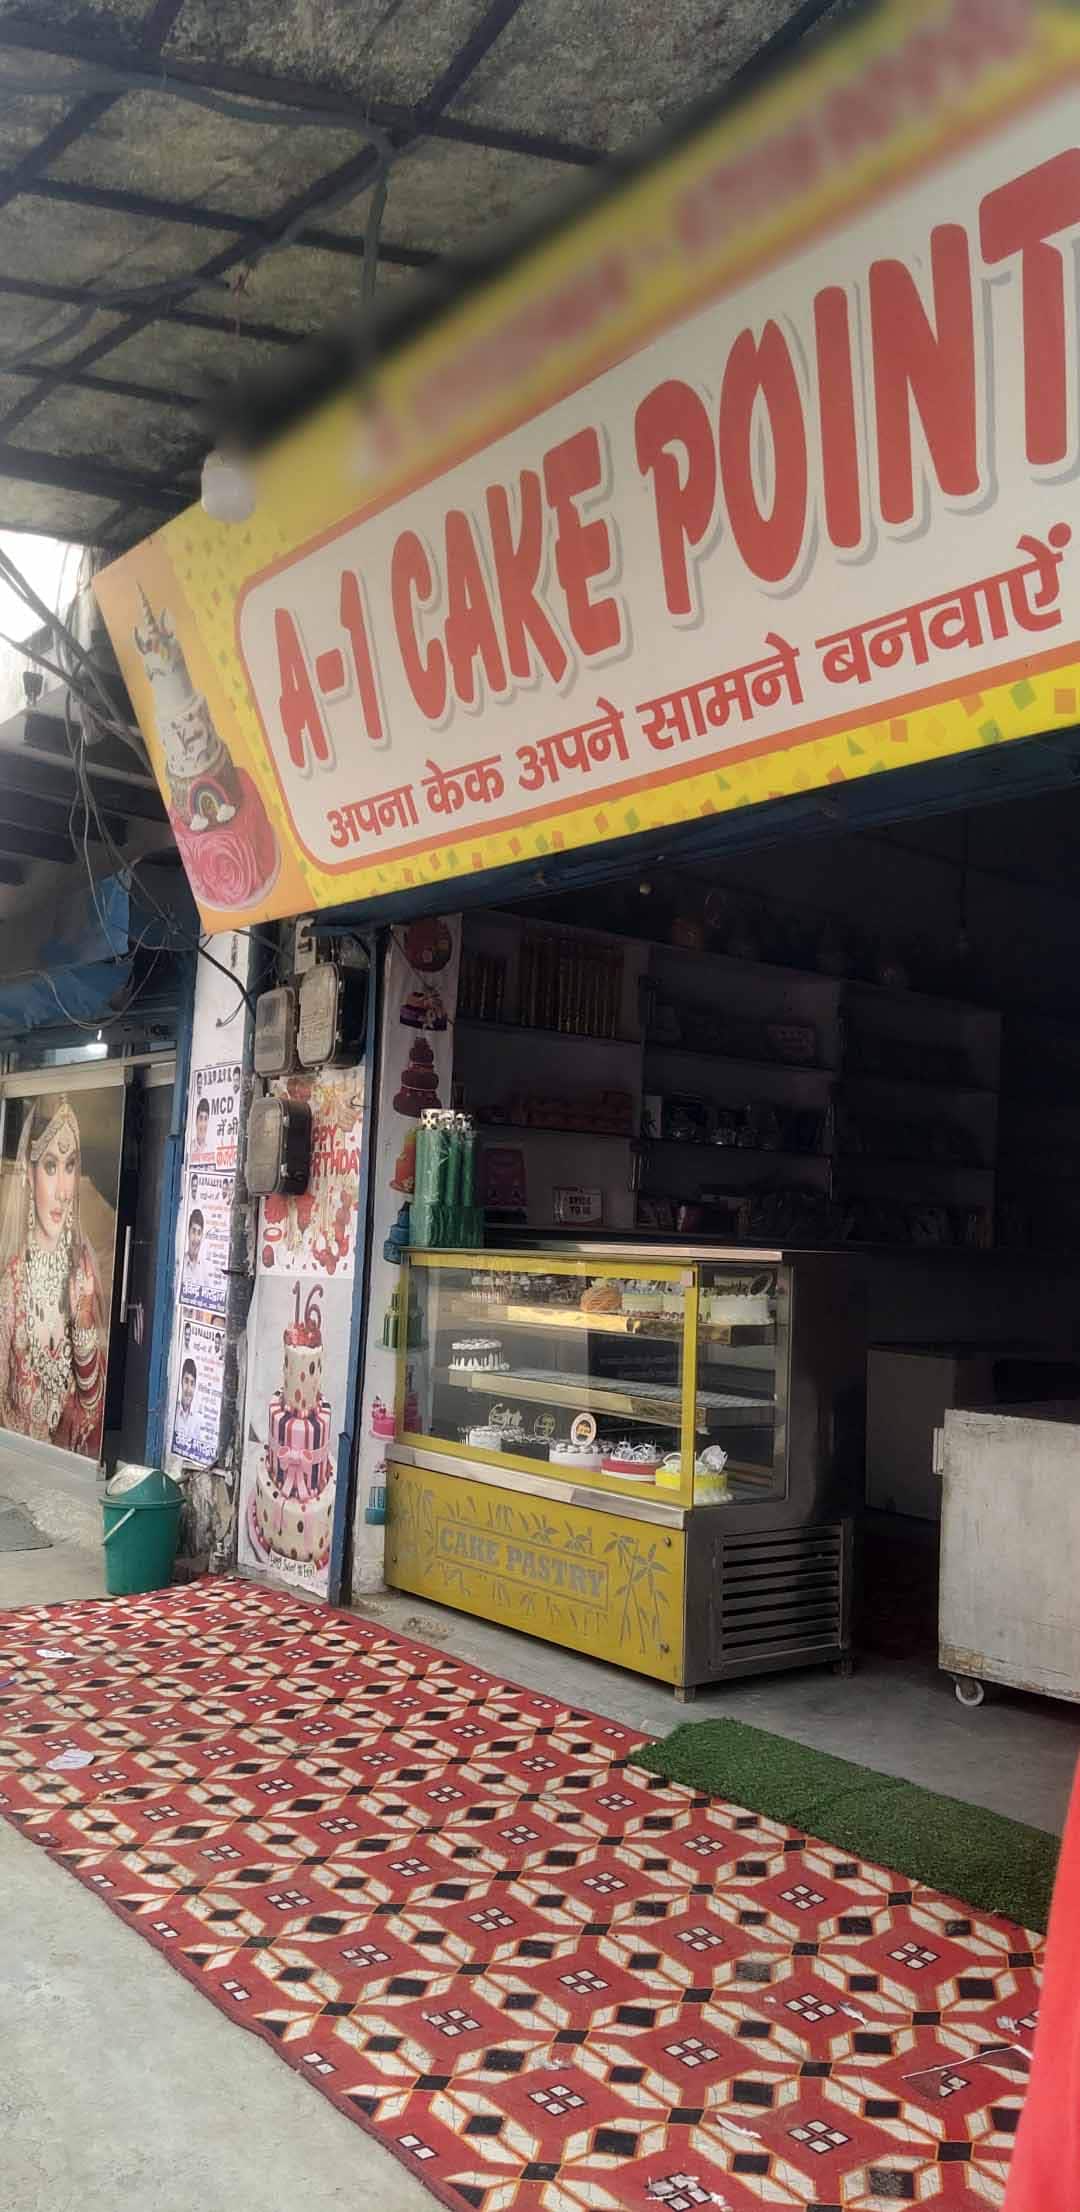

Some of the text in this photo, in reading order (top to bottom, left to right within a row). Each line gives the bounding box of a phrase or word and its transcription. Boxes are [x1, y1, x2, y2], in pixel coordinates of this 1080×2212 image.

[274, 569, 384, 769] A-1
[392, 427, 621, 719] CAKE
[635, 148, 1080, 613] POINT
[326, 784, 420, 848] अपना
[420, 759, 505, 815] केक
[516, 697, 630, 791] अपने
[636, 632, 804, 750] सामने
[211, 1096, 234, 1116] MCD
[312, 1124, 337, 1153] PPY
[292, 1280, 323, 1329] 16
[439, 1526, 605, 1598] CAKE PASTRY
